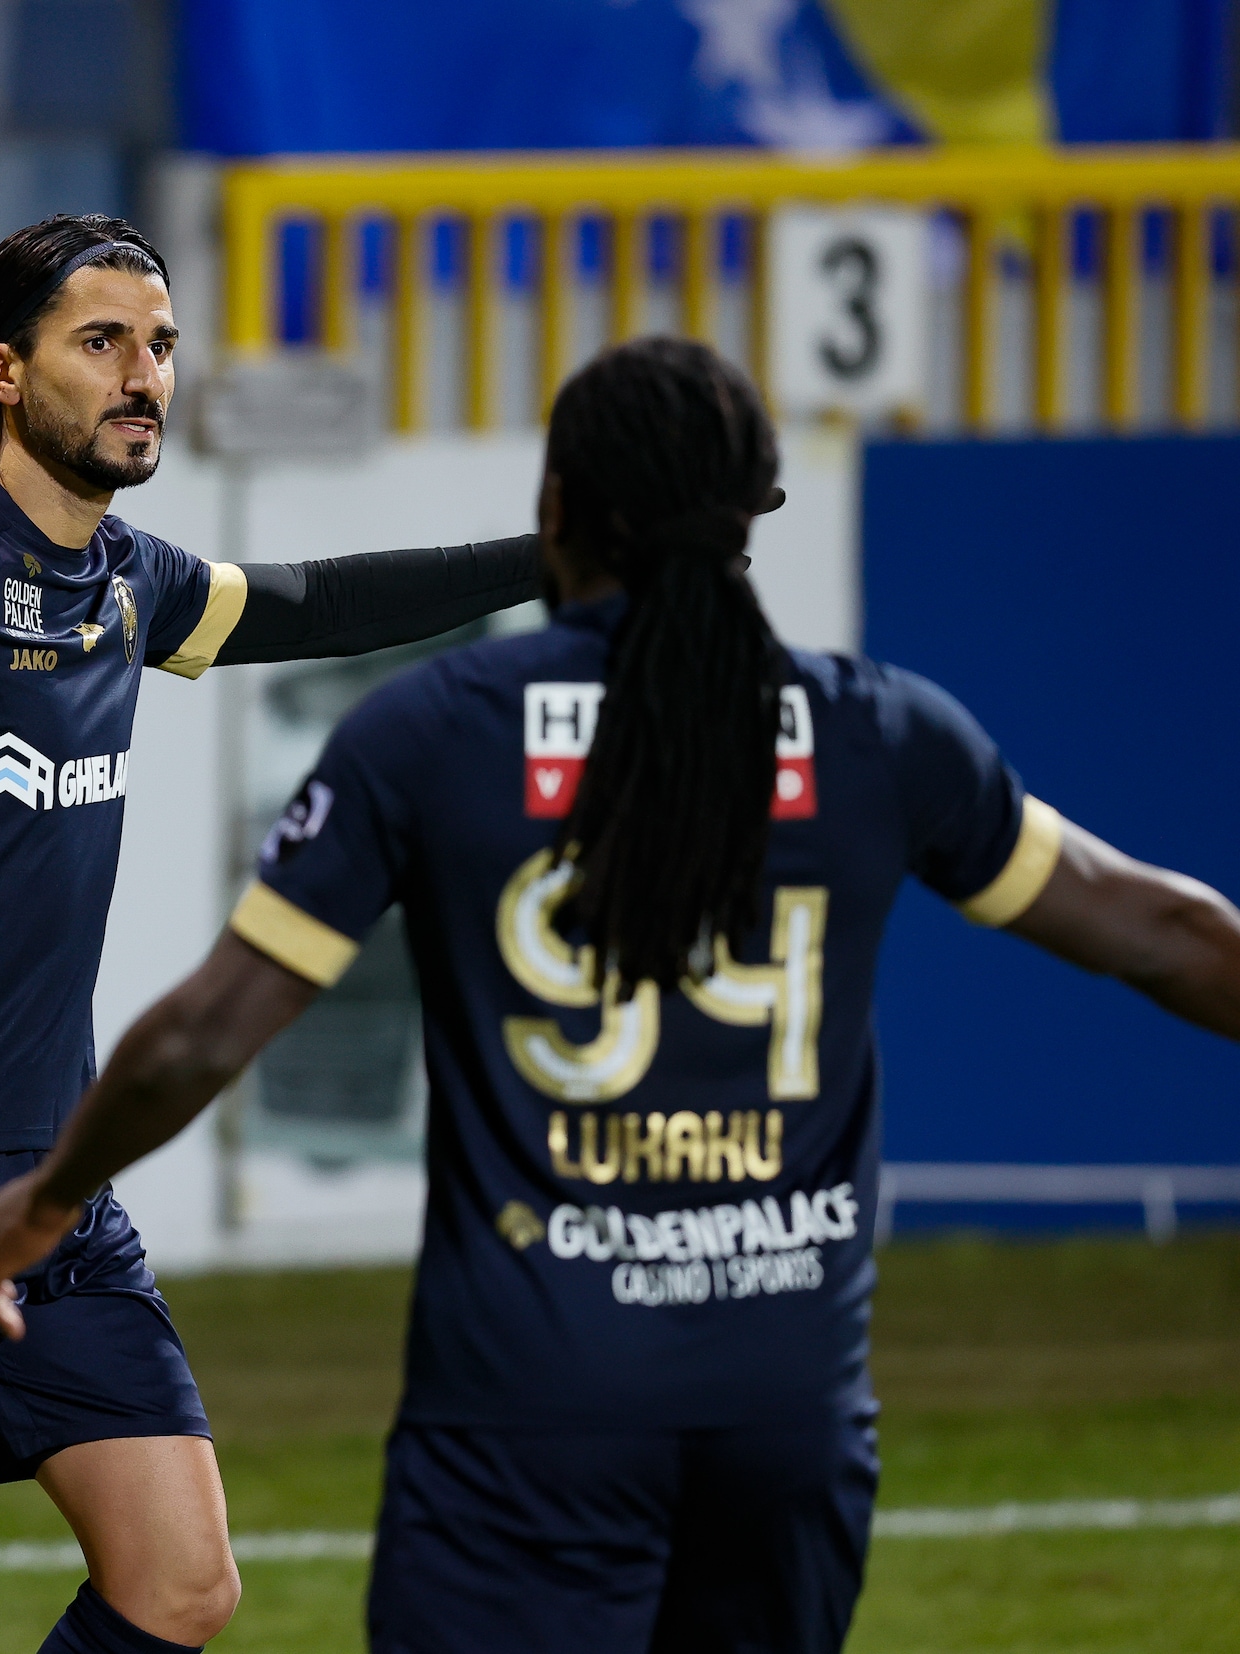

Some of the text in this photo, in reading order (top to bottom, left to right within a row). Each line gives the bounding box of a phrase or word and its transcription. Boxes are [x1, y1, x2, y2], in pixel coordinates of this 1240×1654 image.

[818, 235, 882, 380] 3
[4, 577, 43, 609] GOLDEN
[4, 600, 44, 634] PALACE
[10, 648, 58, 671] JAKO
[58, 748, 130, 808] GHELA
[495, 843, 830, 1102] 94
[547, 1109, 784, 1184] LUKAKU
[612, 1259, 711, 1307] CASINO
